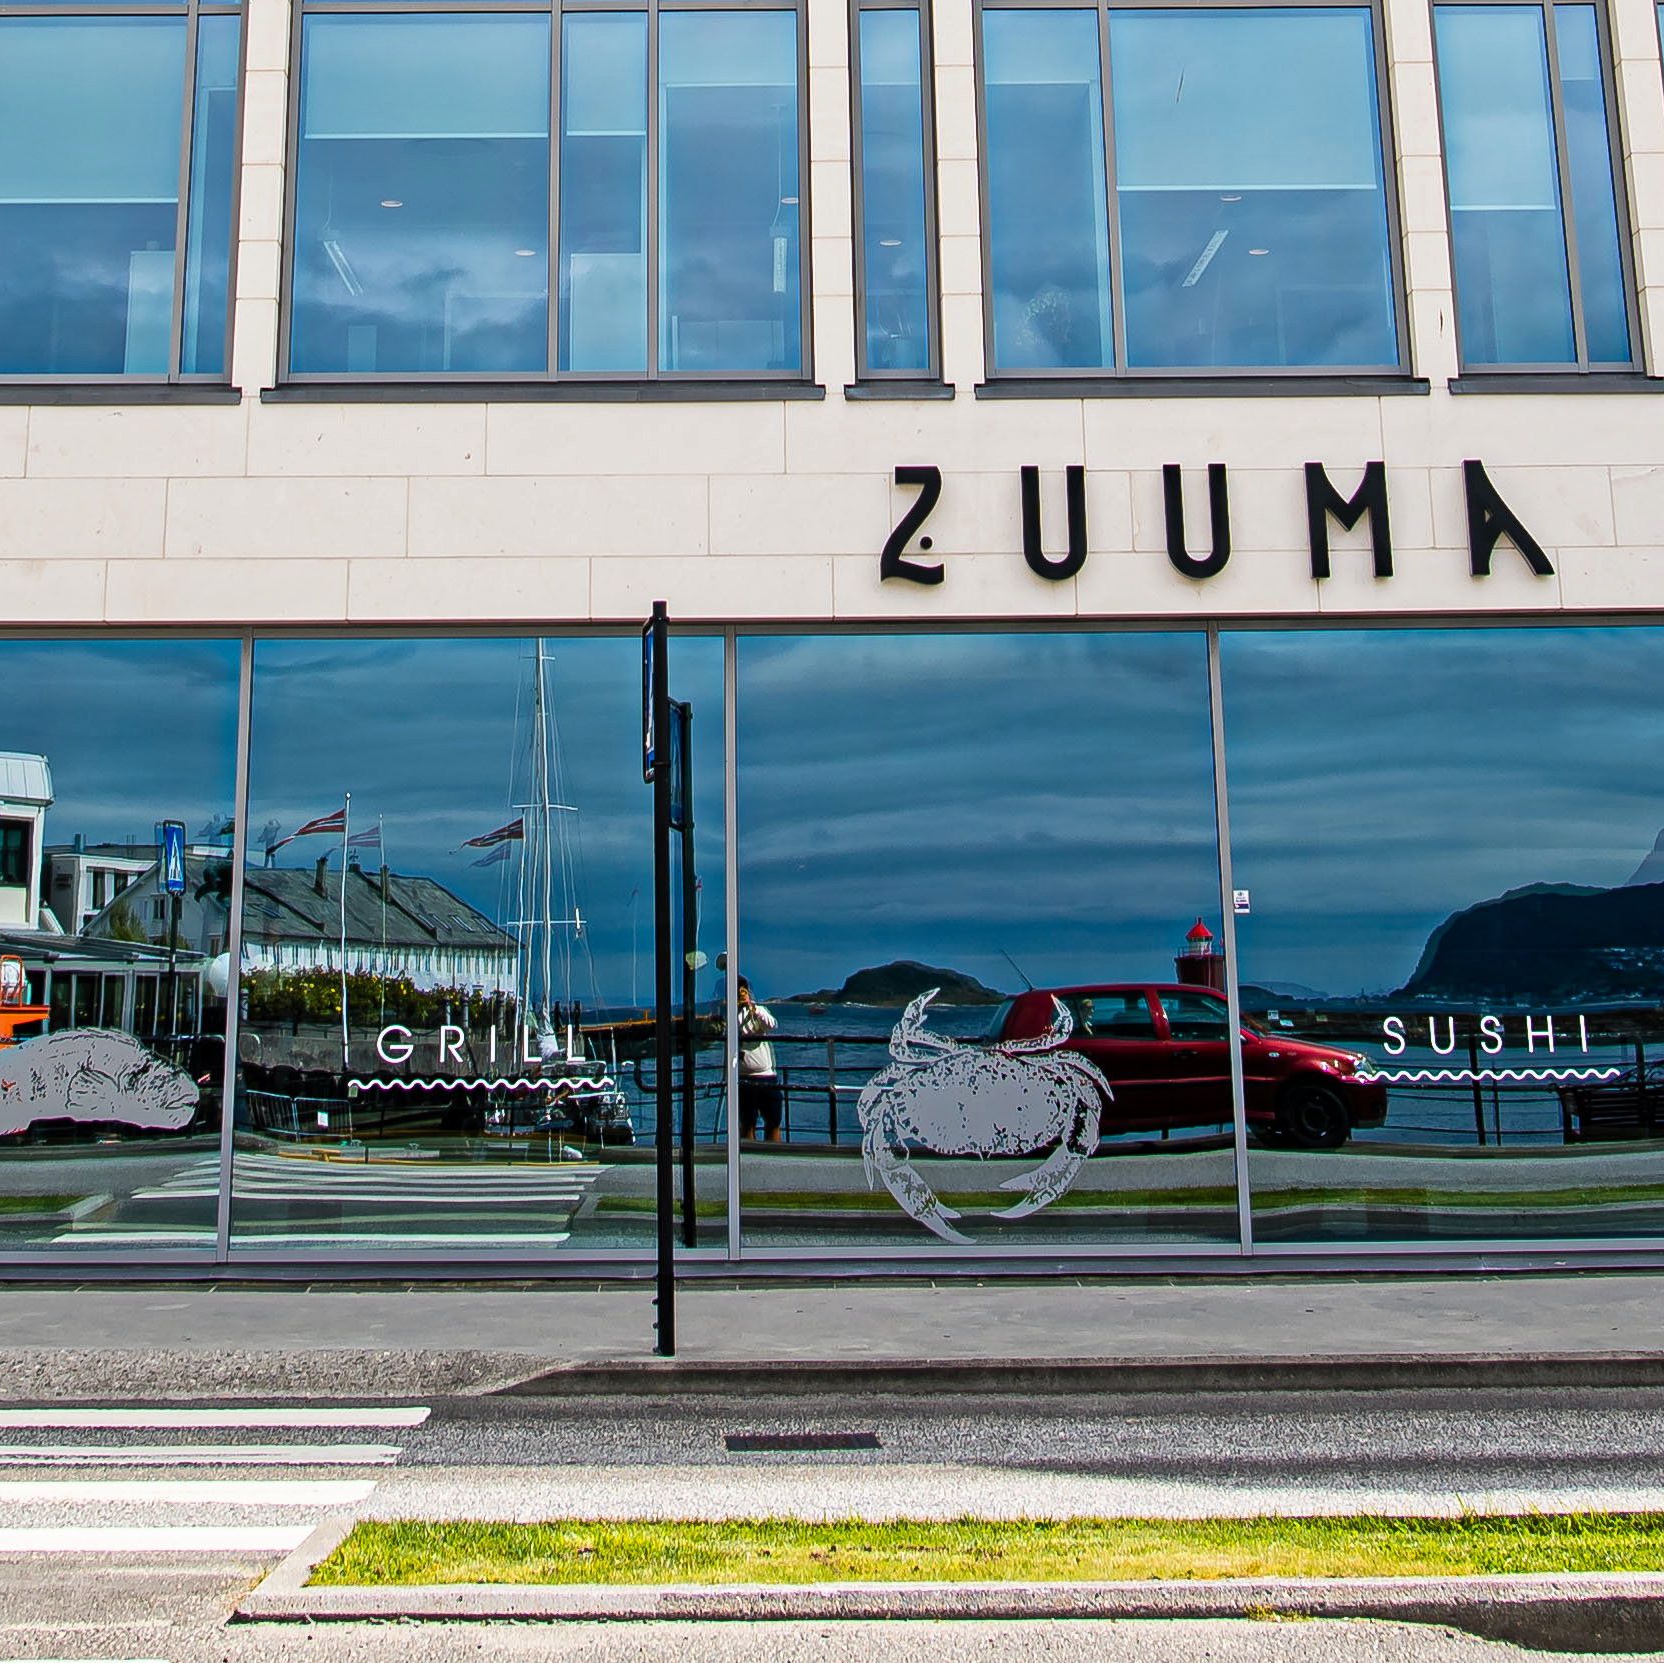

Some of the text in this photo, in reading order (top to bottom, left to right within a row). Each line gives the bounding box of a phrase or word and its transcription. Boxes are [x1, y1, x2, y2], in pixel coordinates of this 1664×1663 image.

[879, 458, 1556, 585] ZUUMA
[376, 1024, 586, 1064] GRILL
[1382, 1015, 1588, 1055] SUSHI
